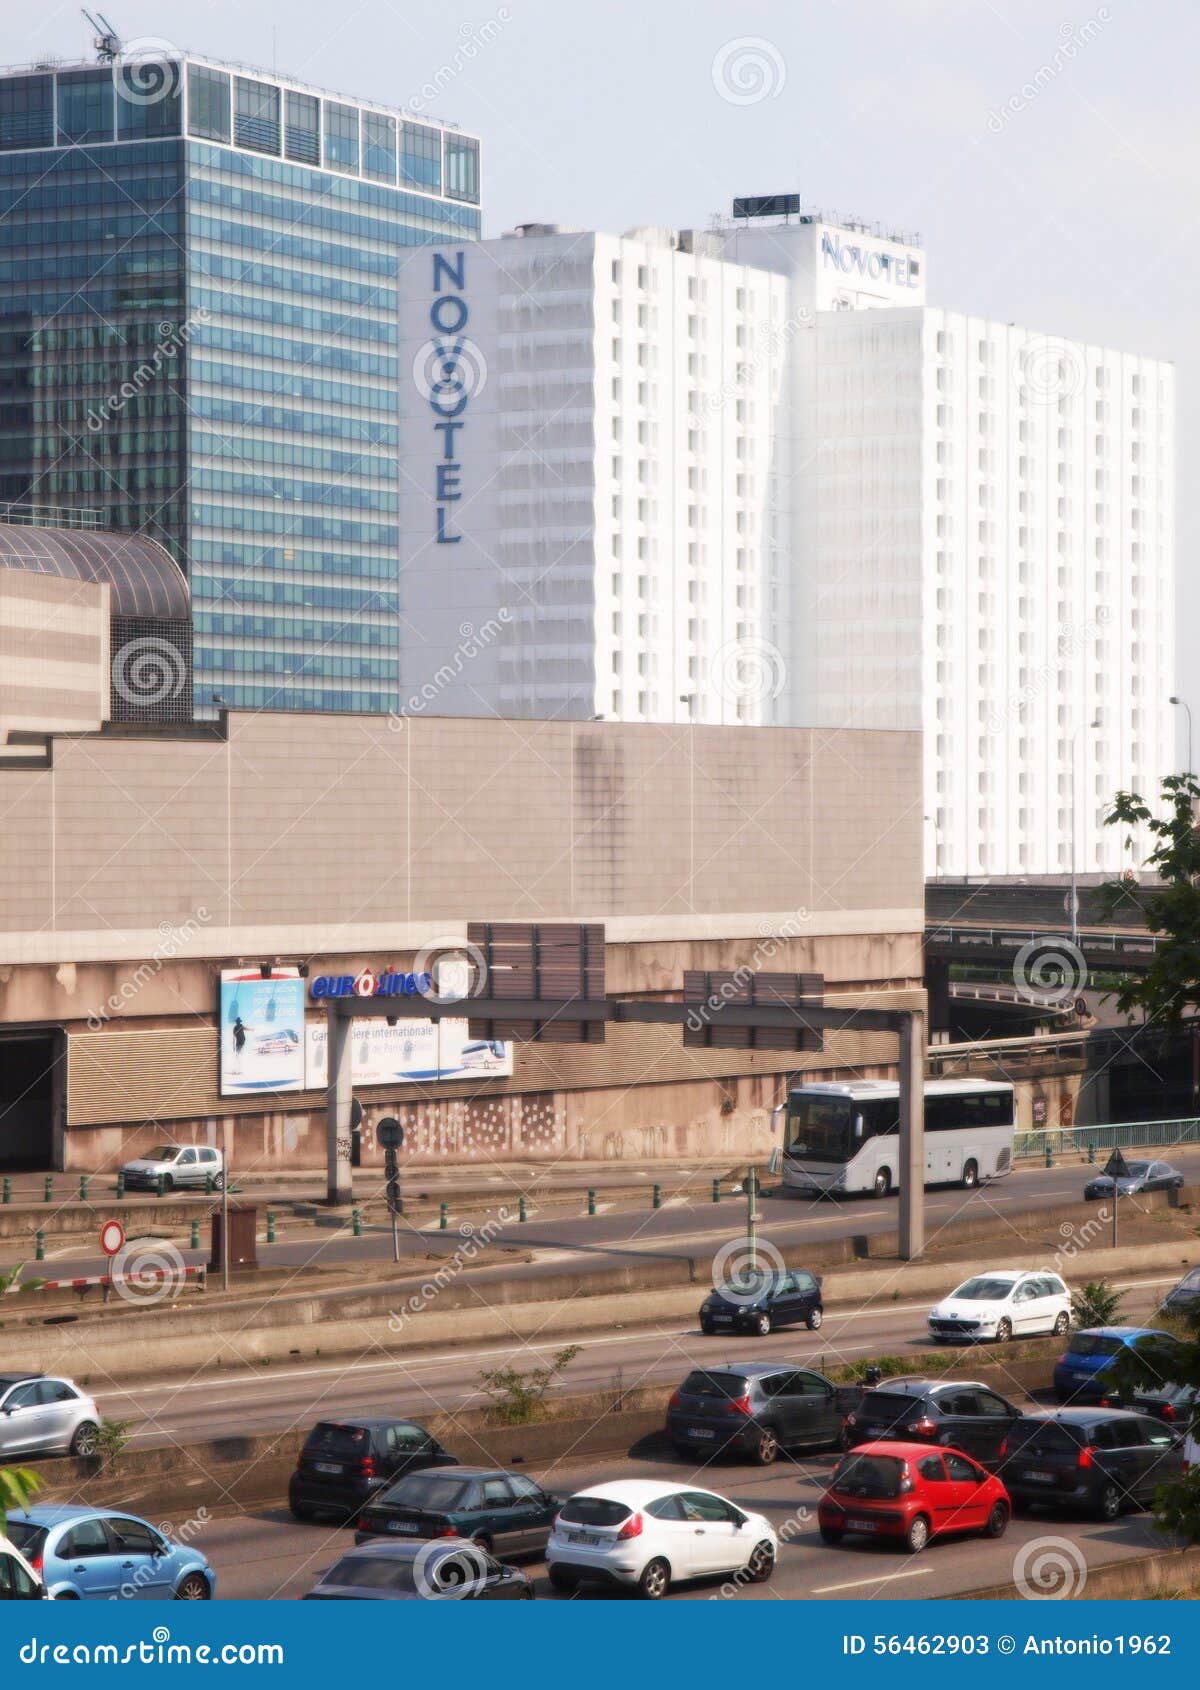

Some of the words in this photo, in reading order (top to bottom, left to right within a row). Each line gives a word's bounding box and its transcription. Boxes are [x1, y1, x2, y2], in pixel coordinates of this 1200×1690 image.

[822, 231, 920, 288] NOVOTEL
[430, 252, 468, 543] NOVOTEL
[372, 1024, 434, 1039] internationale
